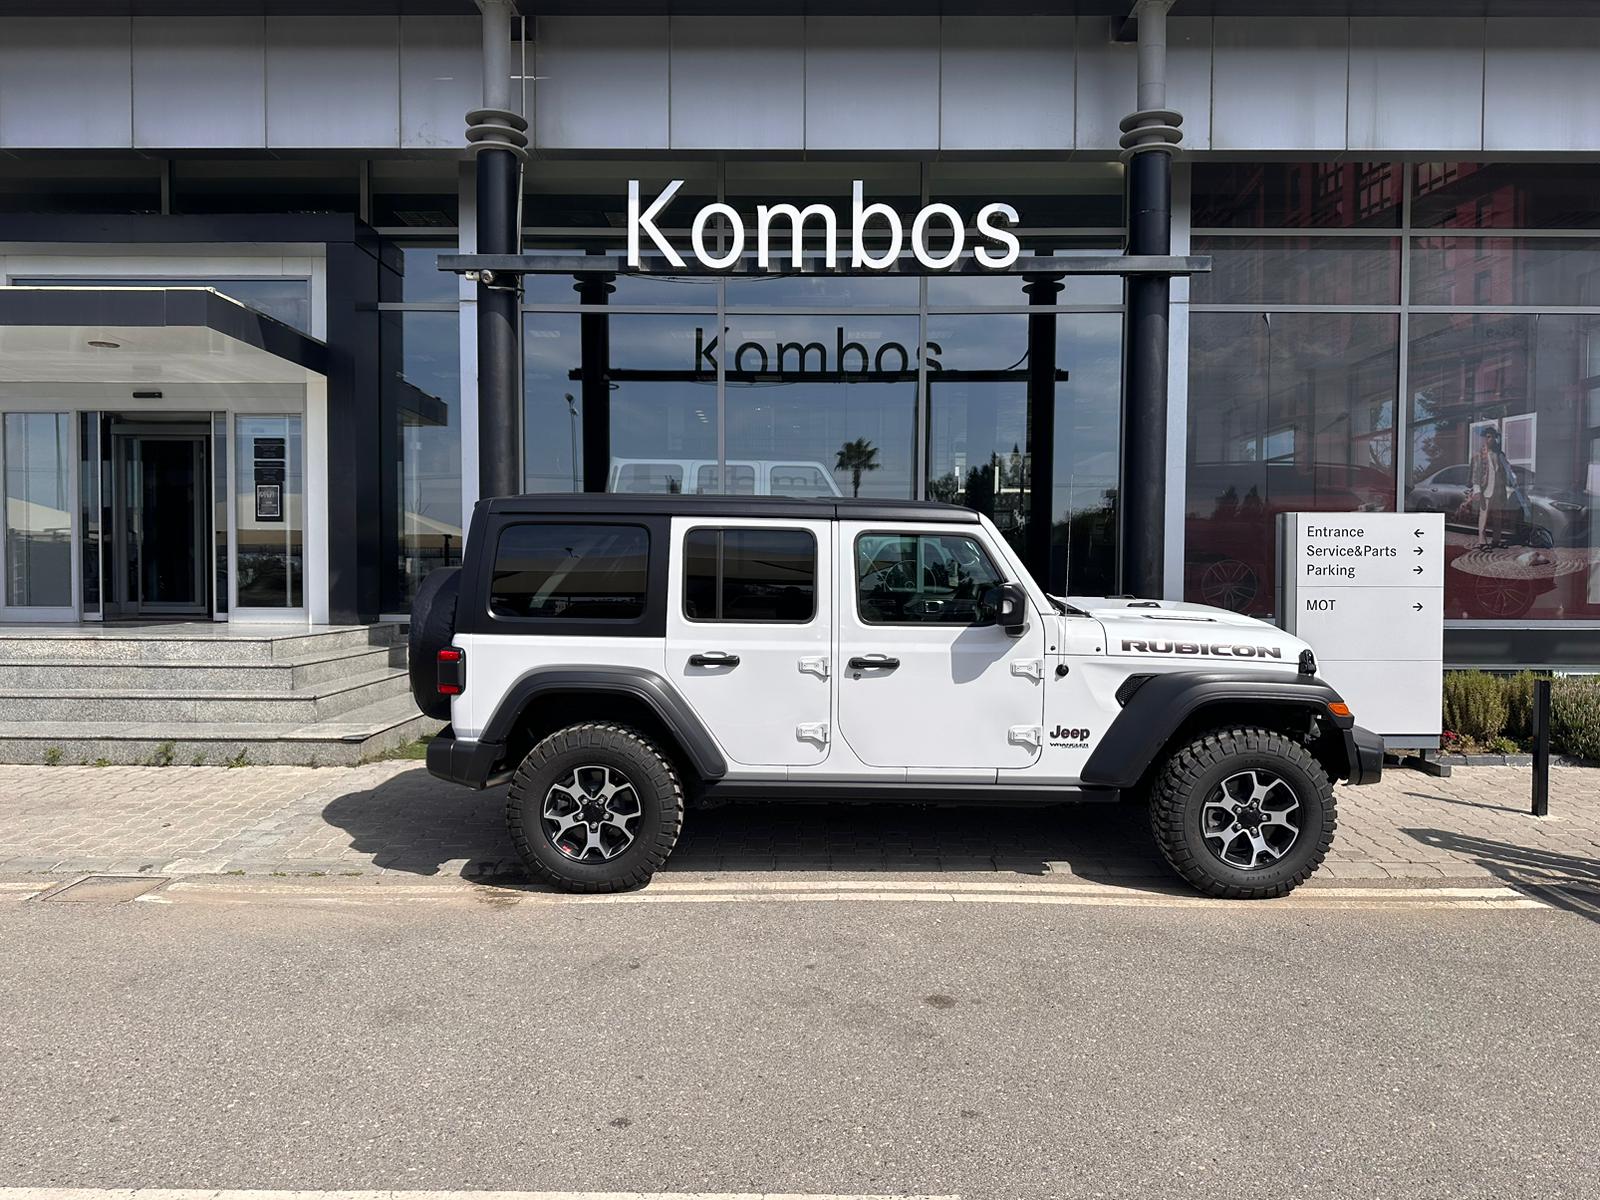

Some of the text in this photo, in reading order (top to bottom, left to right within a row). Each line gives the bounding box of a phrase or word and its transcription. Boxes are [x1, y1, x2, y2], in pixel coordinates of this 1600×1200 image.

[626, 179, 1021, 269] Kombos
[1306, 525, 1365, 538] Entrance
[1306, 544, 1397, 557] Service&Parts
[1306, 564, 1356, 579] Parking
[1306, 599, 1336, 611] MOT
[1121, 639, 1282, 659] RUBICON
[1049, 724, 1090, 741] Jeep
